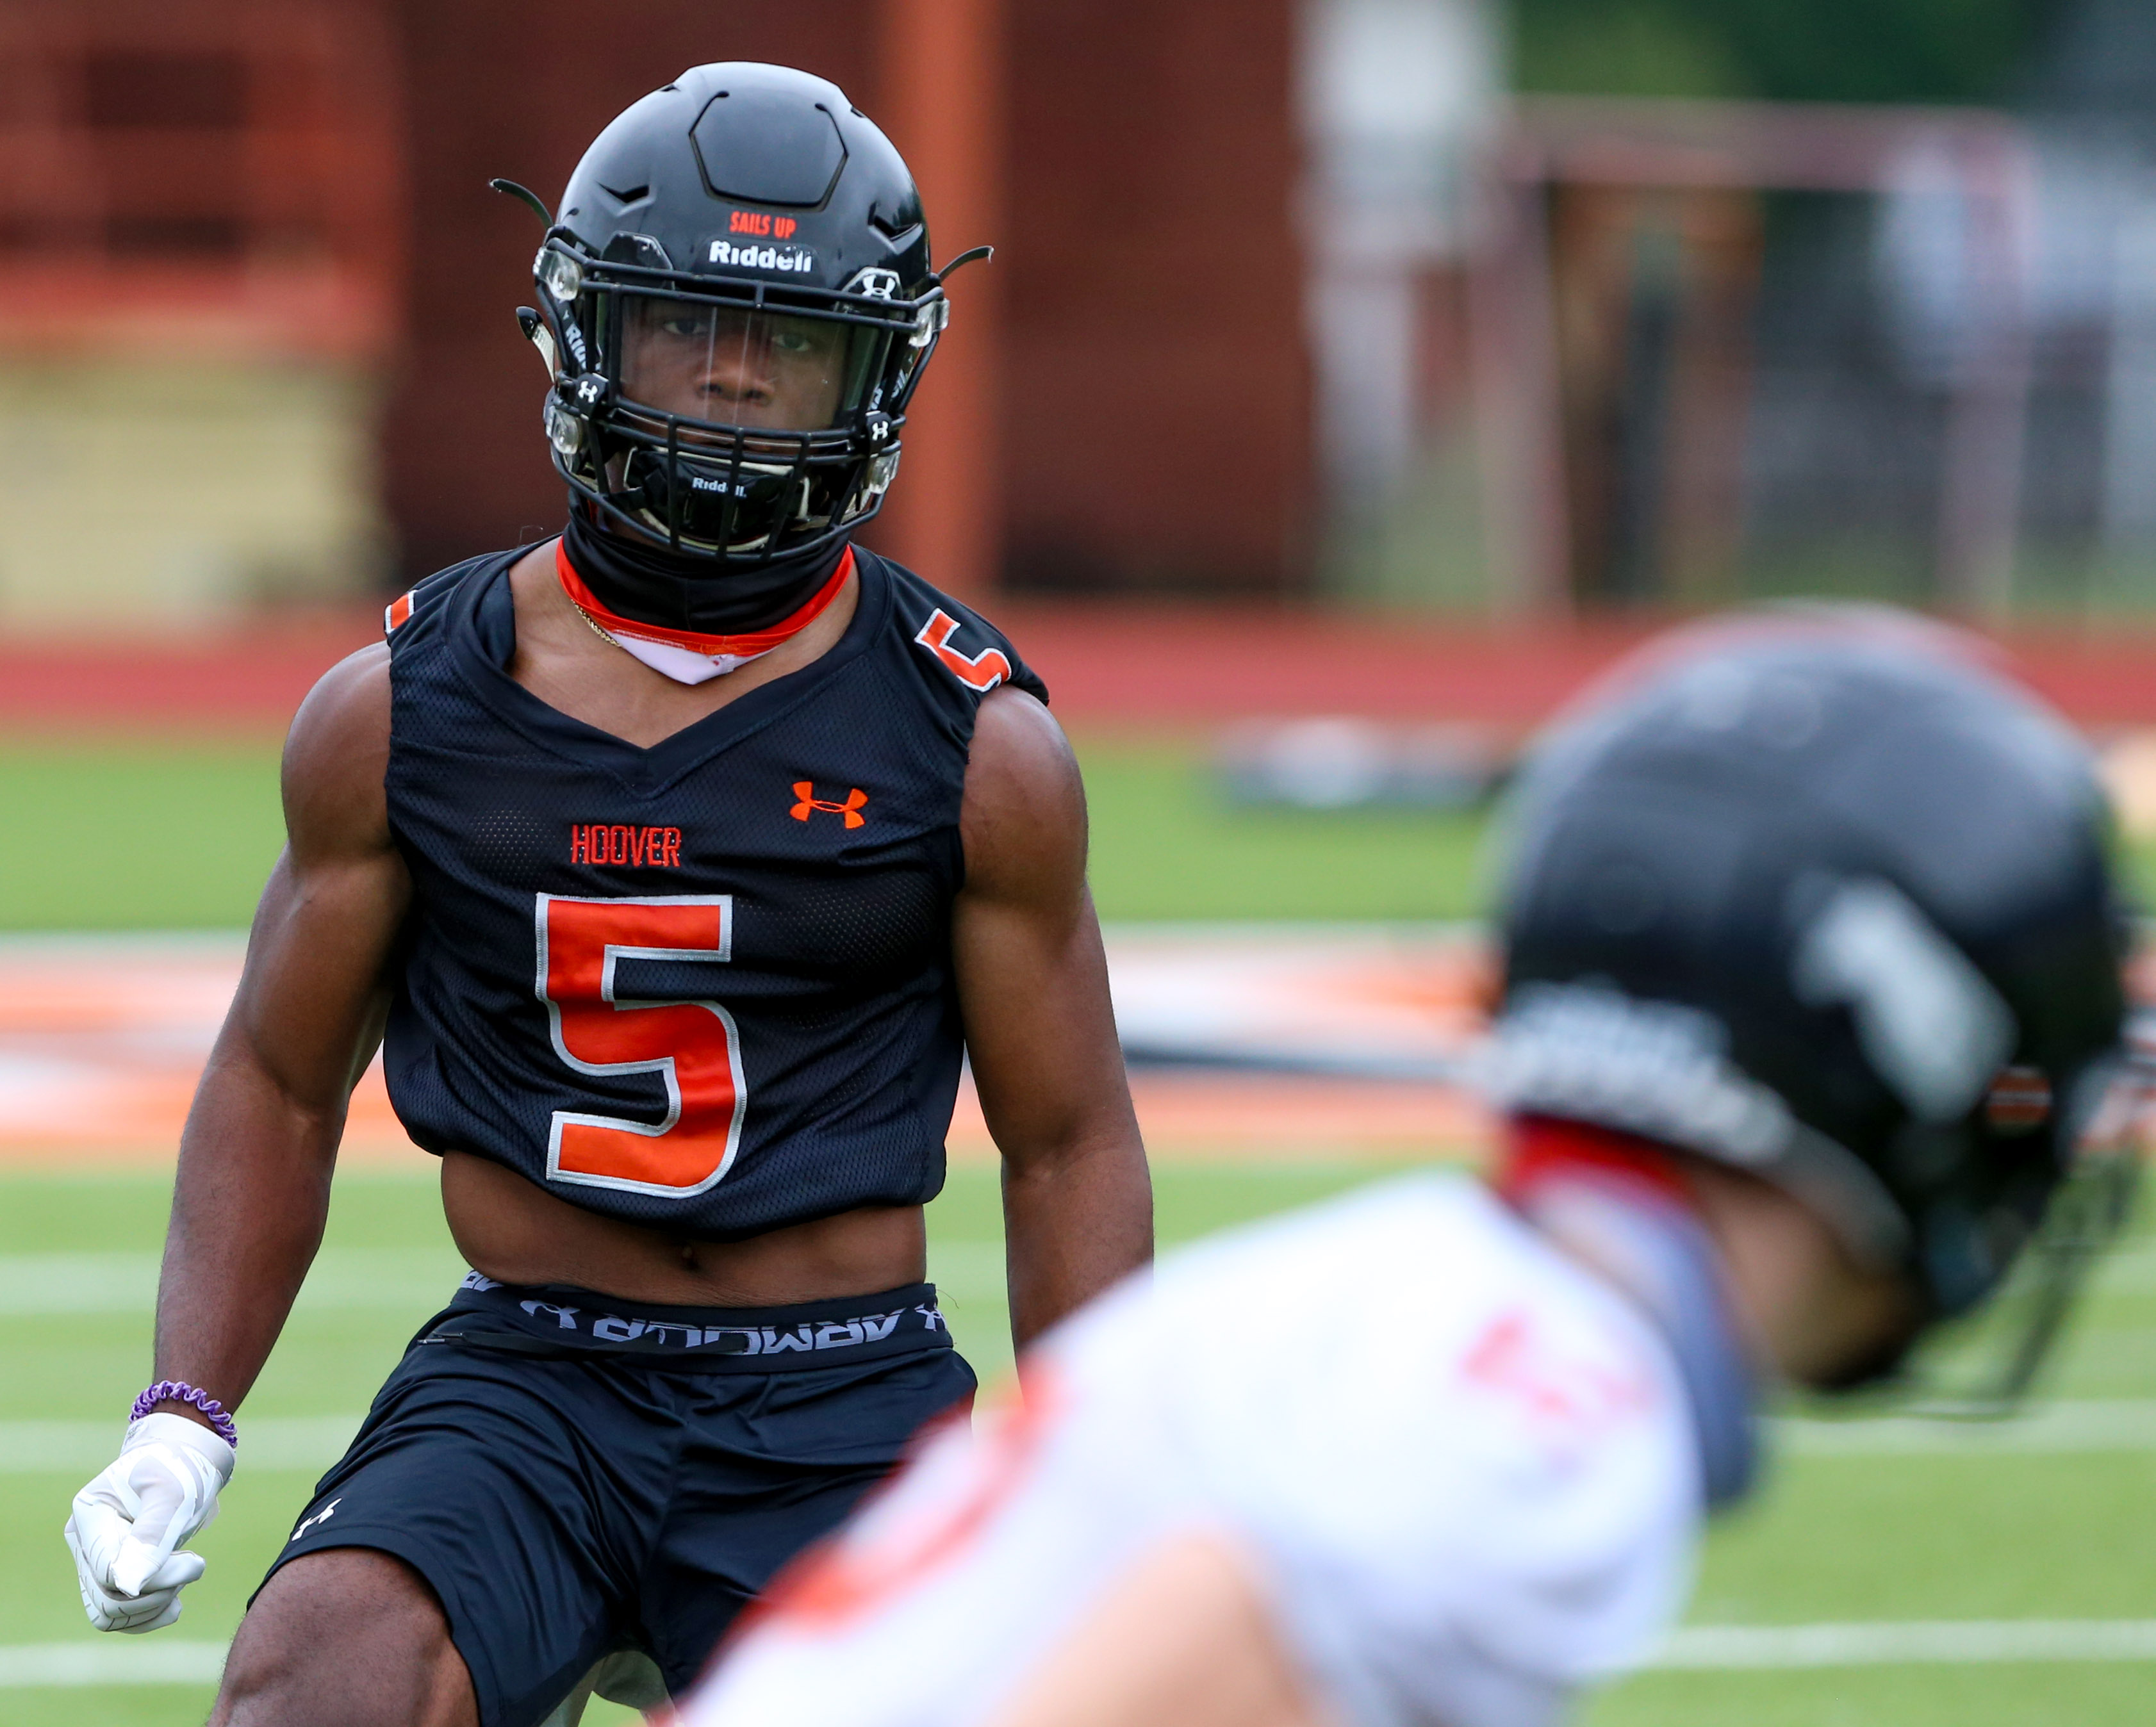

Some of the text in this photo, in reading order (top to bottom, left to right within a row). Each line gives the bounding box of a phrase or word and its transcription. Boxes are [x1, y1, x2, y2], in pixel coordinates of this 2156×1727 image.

[729, 211, 796, 239] SAILS UP
[709, 240, 812, 272] Riddell
[693, 477, 745, 496] Riddll
[571, 824, 681, 867] HOOVER
[535, 892, 747, 1199] 5
